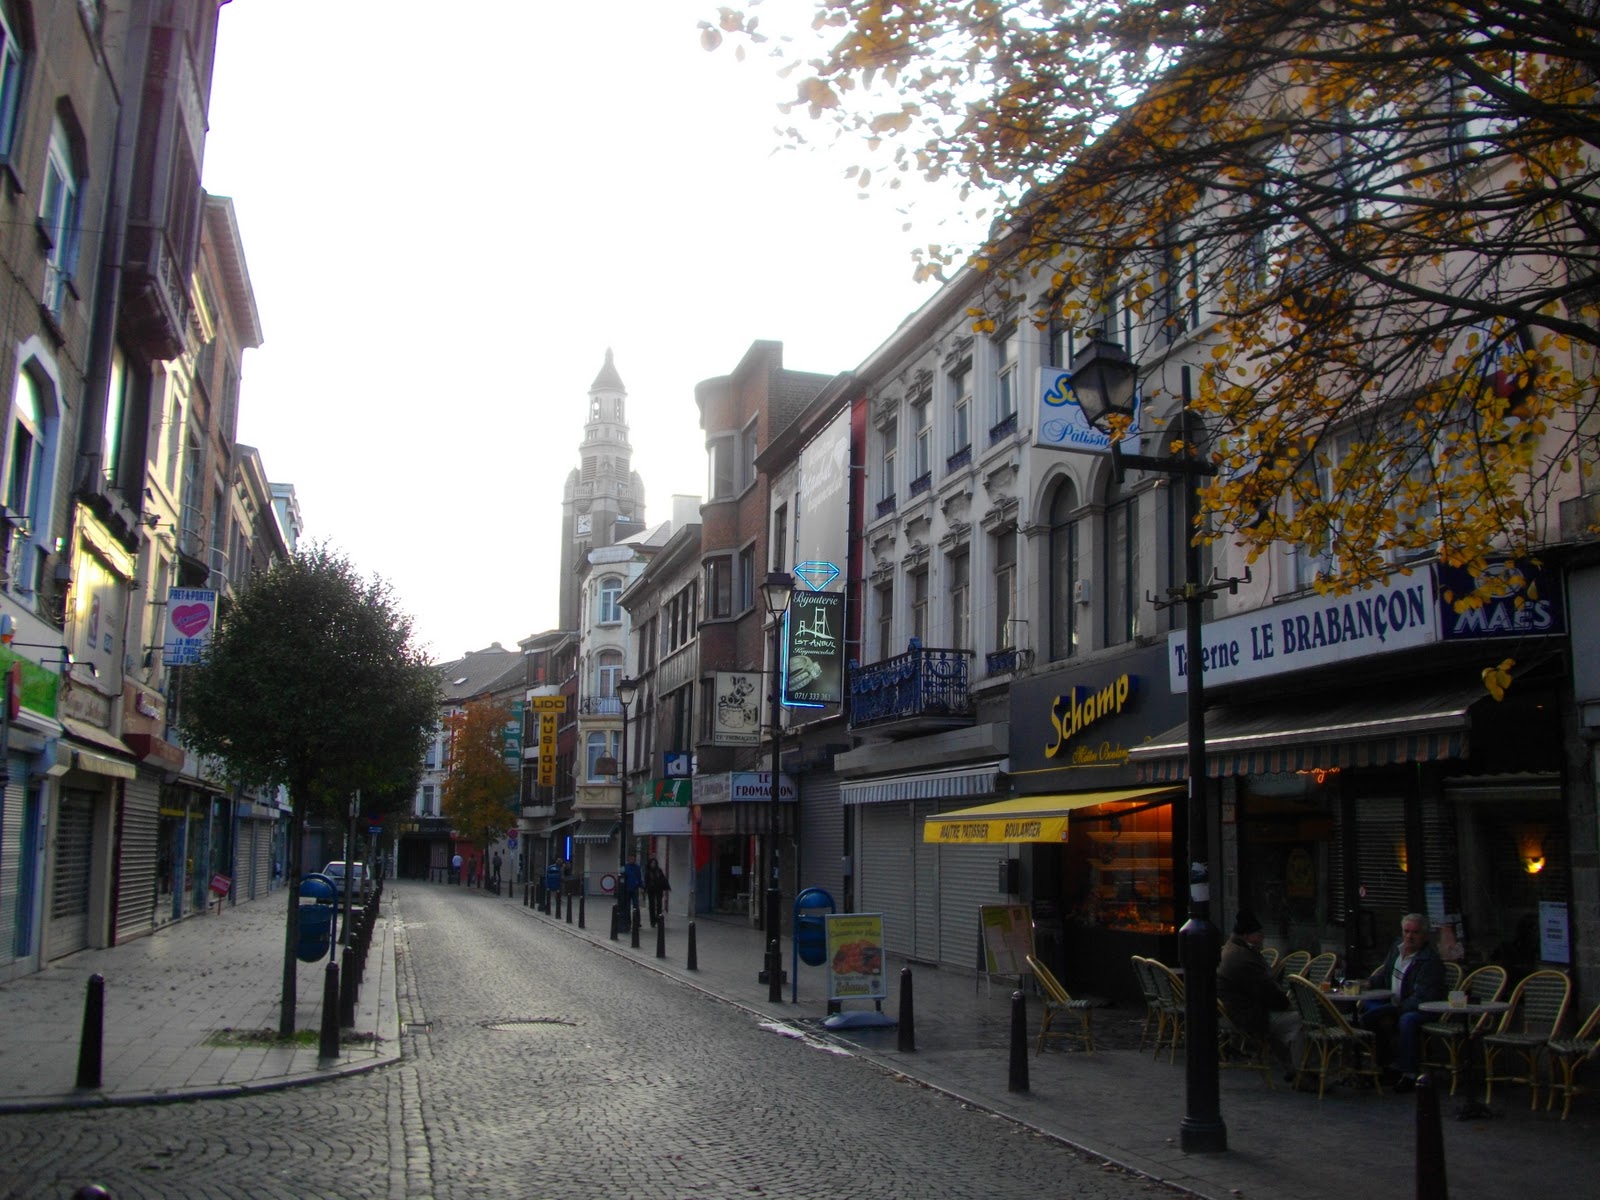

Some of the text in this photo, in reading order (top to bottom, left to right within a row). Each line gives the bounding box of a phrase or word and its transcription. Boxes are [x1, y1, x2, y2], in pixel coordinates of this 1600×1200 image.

[793, 591, 839, 608] Bijouterie
[1453, 600, 1553, 634] MAES
[1175, 585, 1426, 677] Terne LE BRABANÇON
[175, 638, 183, 646] LA
[174, 647, 181, 655] LE
[533, 700, 565, 709] LIDO
[1045, 673, 1130, 759] Schamp
[542, 715, 554, 784] MUSIQUE
[759, 773, 770, 784] LE
[735, 785, 793, 797] FROMAON
[1004, 822, 1042, 838] BOULANGER
